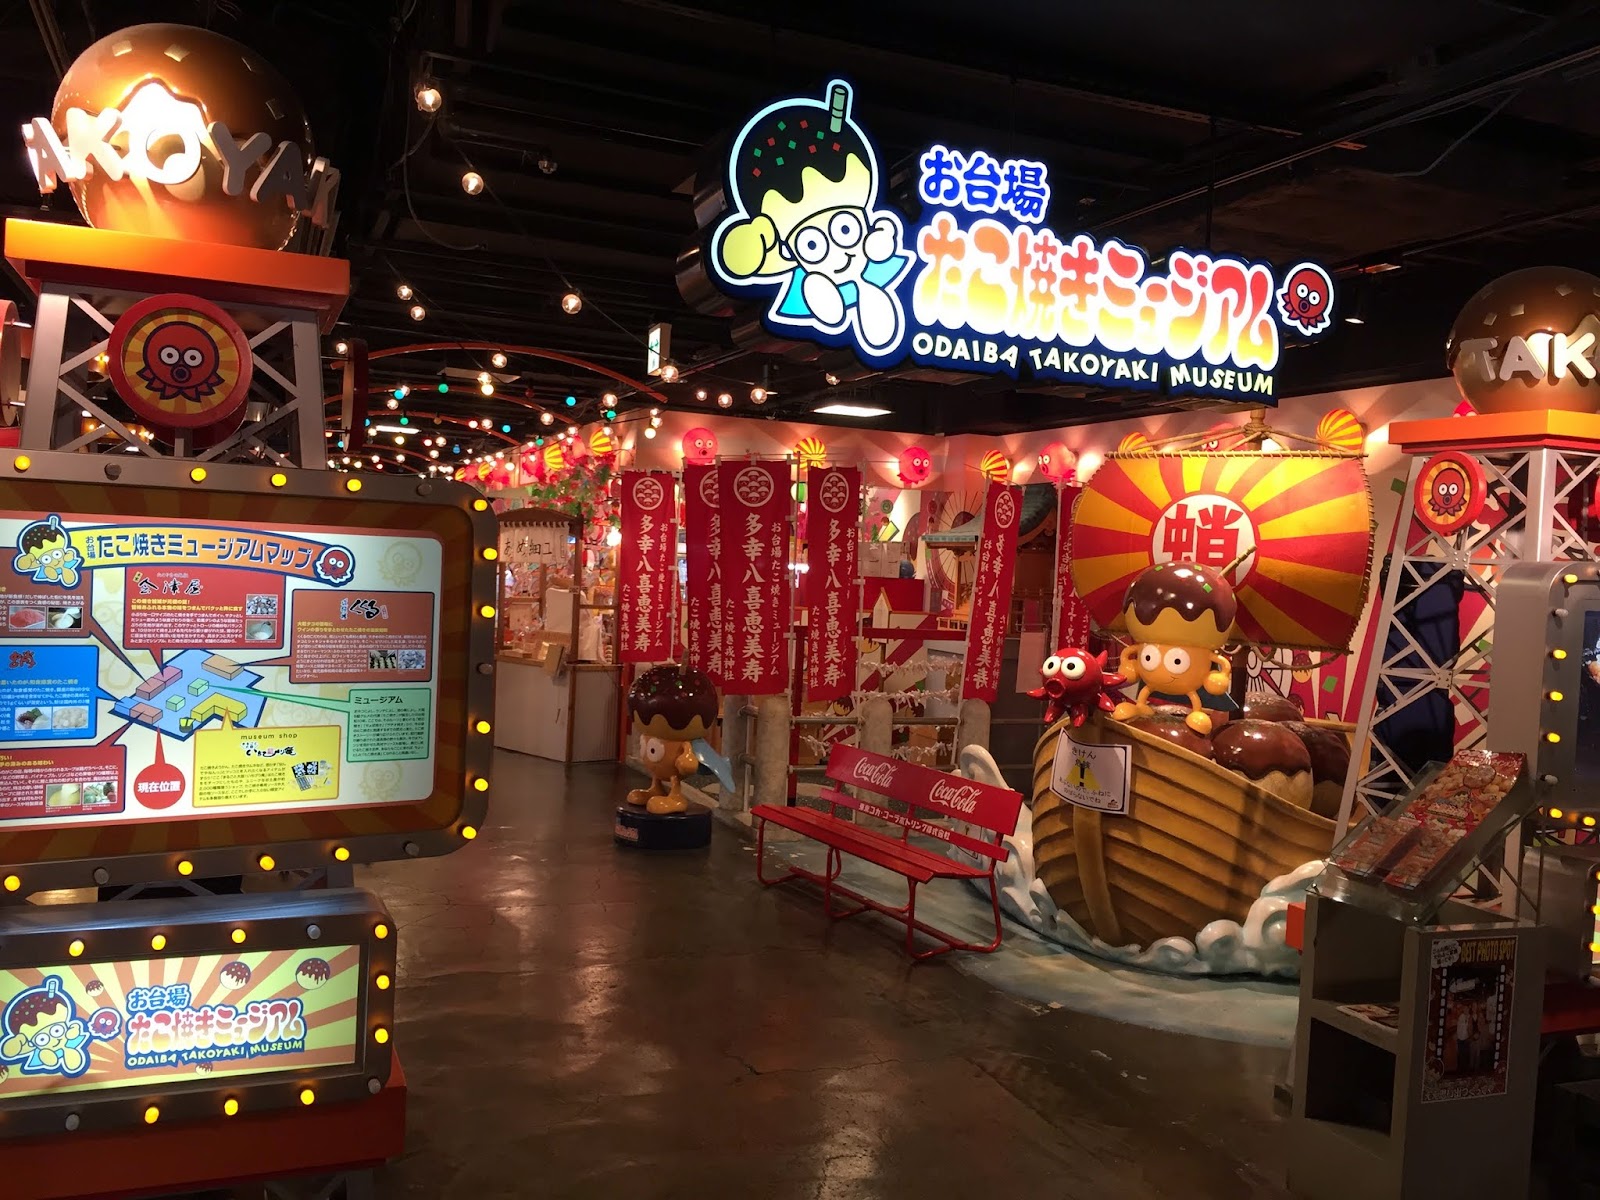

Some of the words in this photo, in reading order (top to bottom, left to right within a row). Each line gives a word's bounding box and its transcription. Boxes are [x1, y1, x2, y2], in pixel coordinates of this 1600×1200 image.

[921, 148, 1048, 220] お台場
[912, 332, 1019, 369] ODAIBA
[1029, 347, 1159, 383] TAKOYAKI
[1170, 362, 1274, 395] MUSEUM
[97, 533, 313, 570] たこ焼きミュージアムマップ
[634, 514, 655, 653] 多幸八喜恵美寿
[741, 512, 766, 683] 多幸八喜恵美寿
[823, 518, 842, 688] 多幸八喜恵美寿
[354, 696, 403, 705] ミュージアム
[1072, 746, 1097, 760] きけん
[137, 780, 181, 793] 現在位置
[853, 756, 898, 788] Coca-Cola
[929, 779, 982, 814] Coca-Cola
[128, 986, 187, 1010] お台場
[127, 1054, 178, 1067] ODAIBA
[182, 1046, 245, 1062] TAKOYAKI
[250, 1041, 303, 1055] MUSEUM
